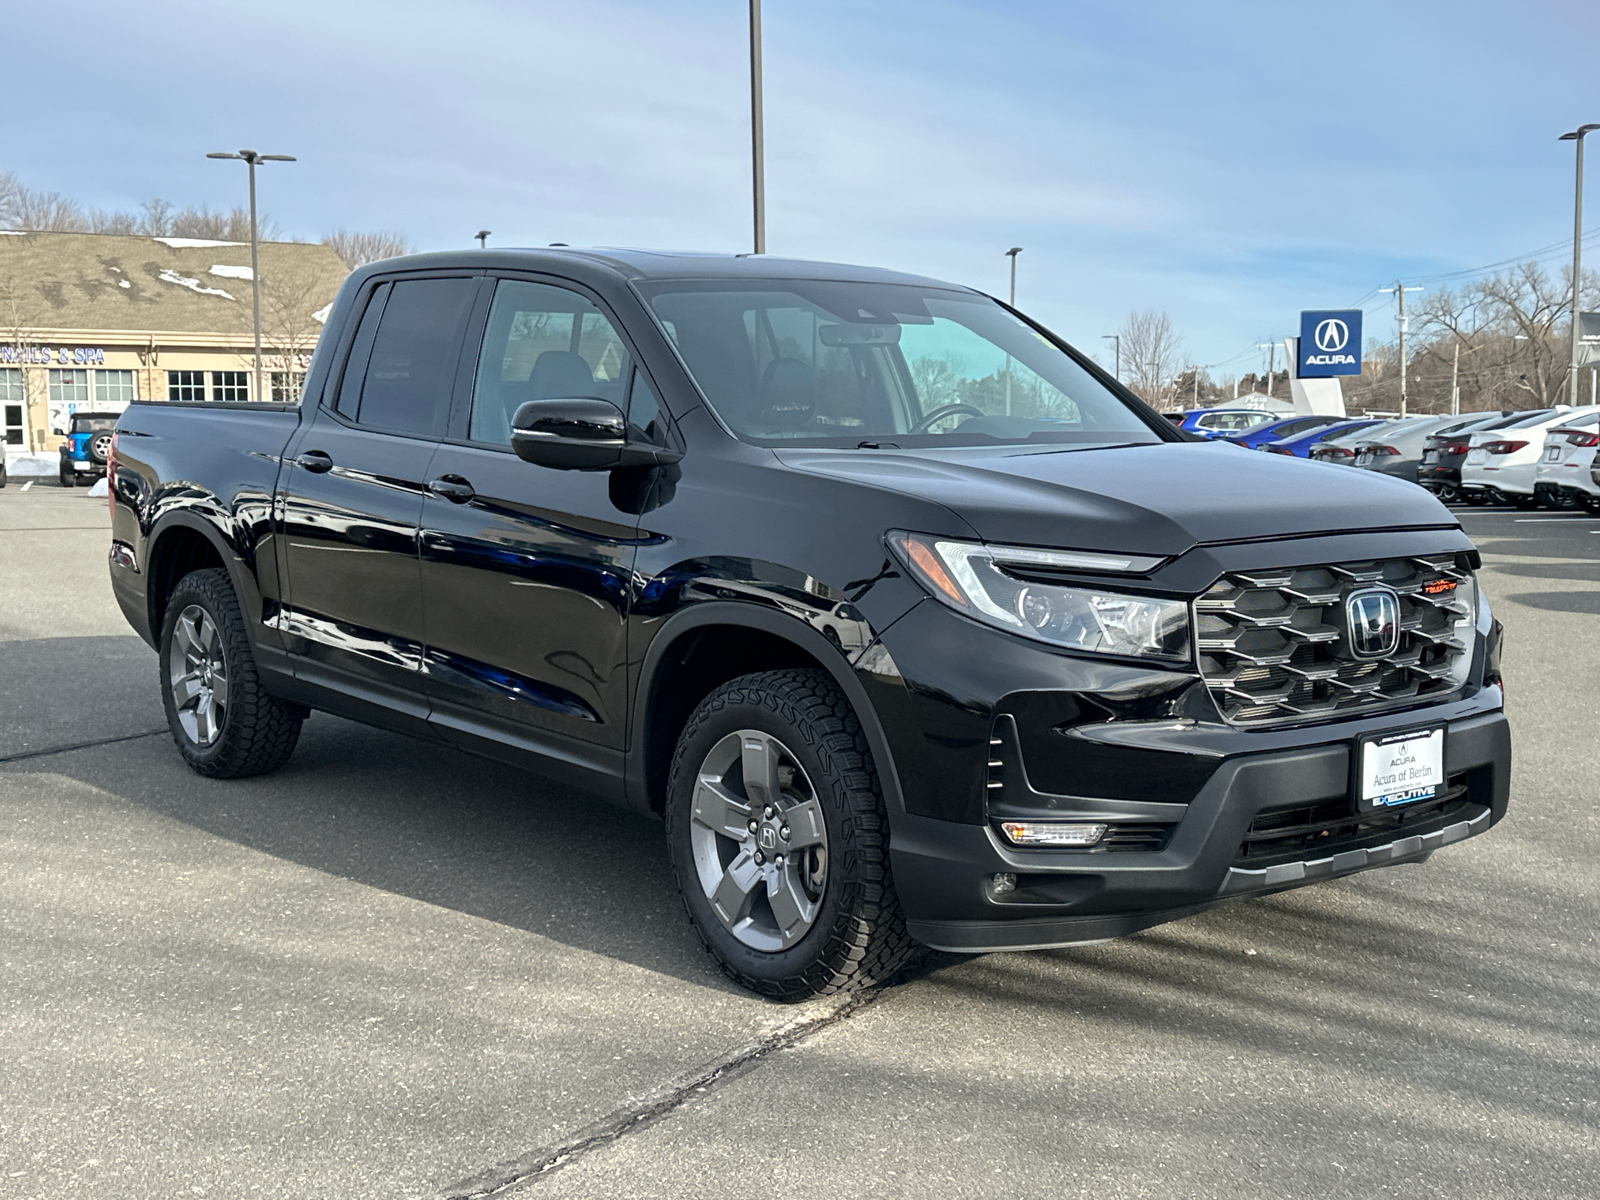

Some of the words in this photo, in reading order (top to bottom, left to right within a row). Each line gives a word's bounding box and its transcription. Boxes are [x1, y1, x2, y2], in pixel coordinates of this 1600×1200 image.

[1, 346, 51, 363] NAILS
[59, 347, 69, 364] &
[74, 347, 105, 364] SPA
[1305, 354, 1356, 365] ACURA
[1390, 755, 1416, 767] ACURA
[1373, 774, 1396, 786] Acura
[1398, 769, 1407, 781] of
[1408, 764, 1432, 779] Berlin
[1373, 786, 1436, 807] EXECUTIVE
